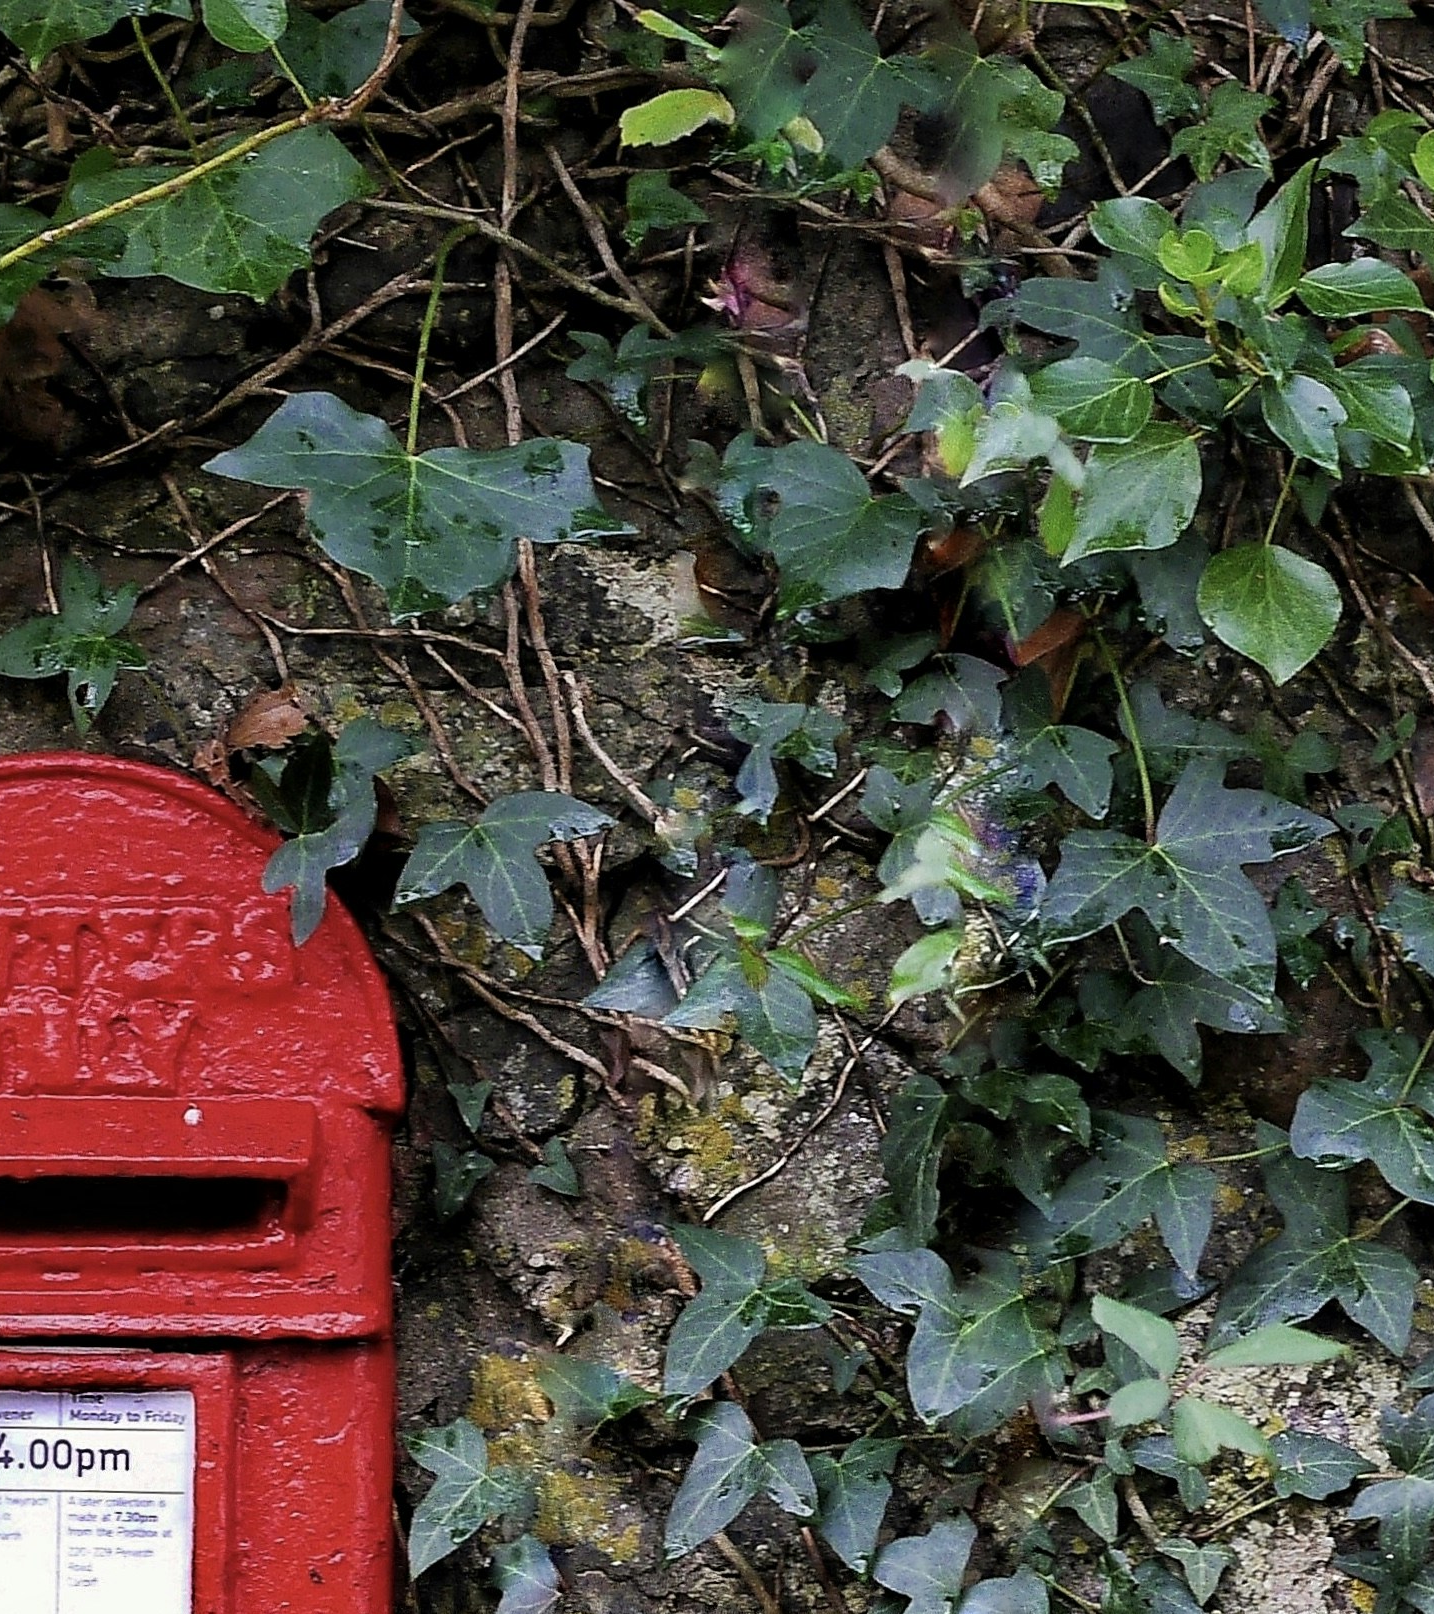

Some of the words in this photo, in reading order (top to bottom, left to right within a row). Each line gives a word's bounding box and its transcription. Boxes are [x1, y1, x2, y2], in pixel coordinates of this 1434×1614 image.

[70, 1410, 122, 1424] Monday
[126, 1411, 142, 1422] to
[145, 1410, 186, 1425] Friday
[114, 1511, 158, 1524] 7.30pm
